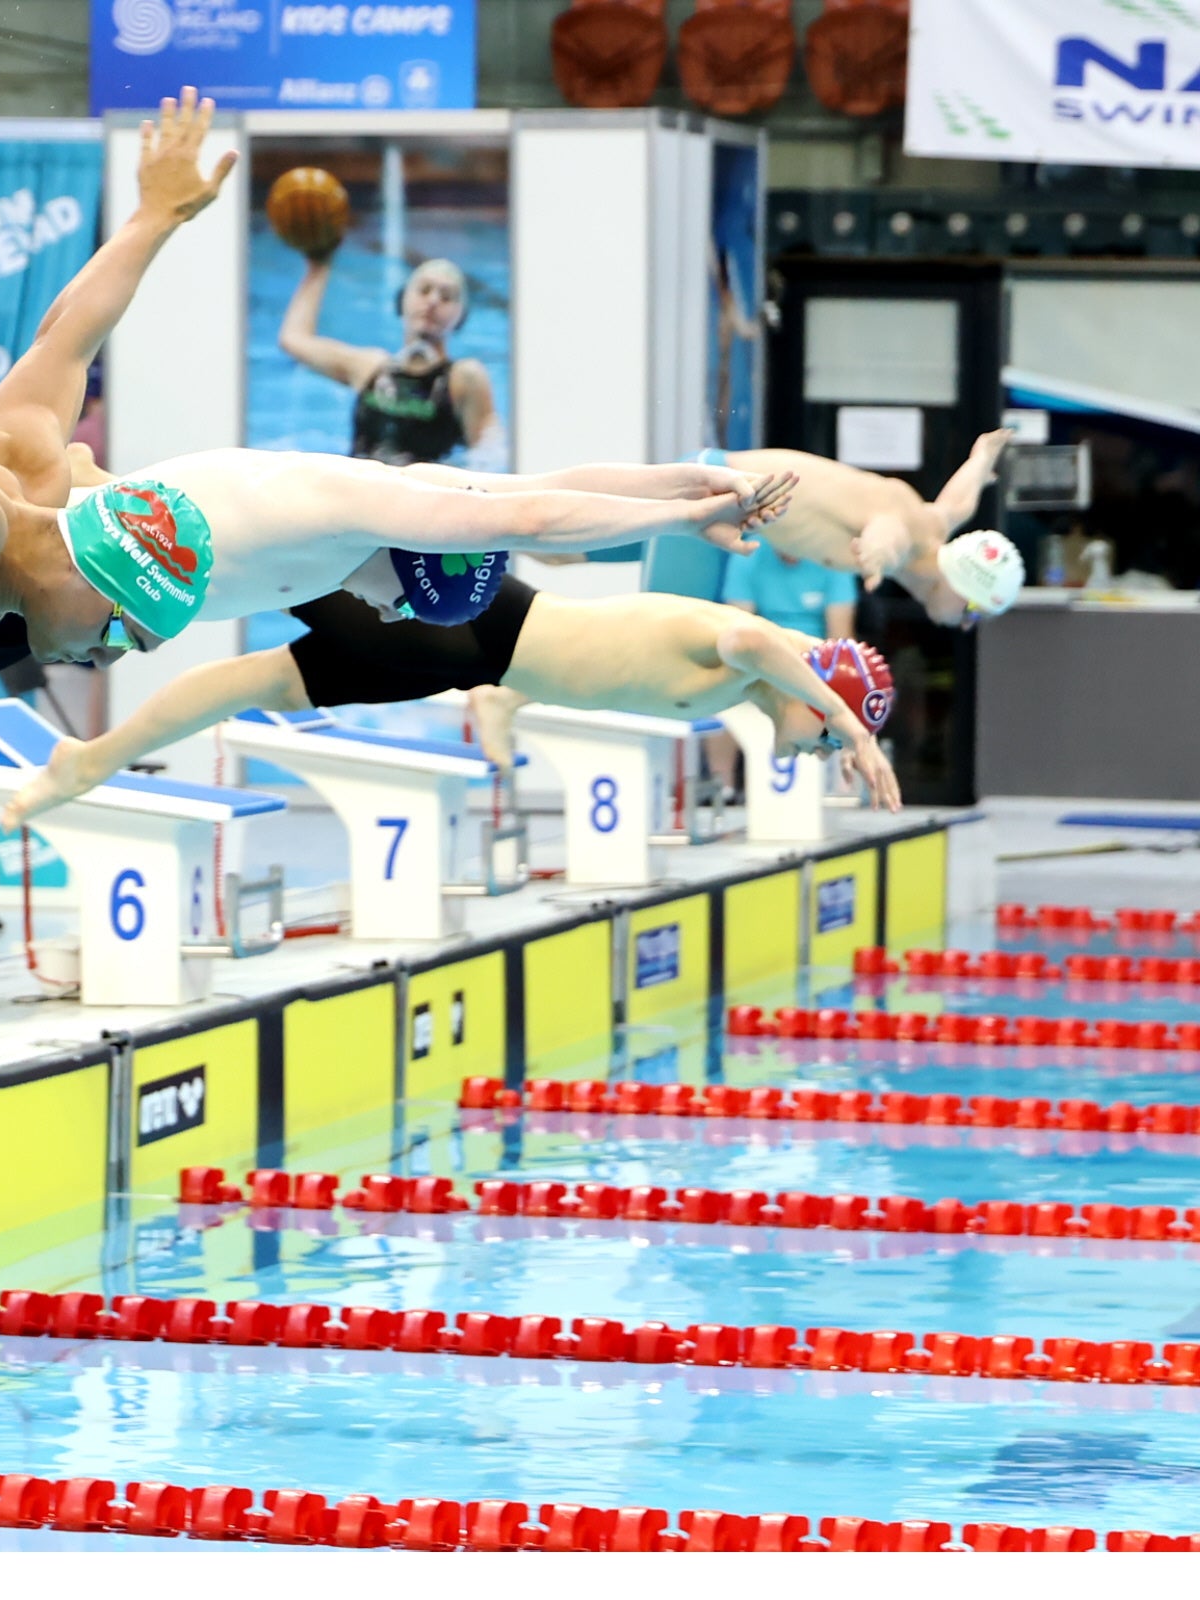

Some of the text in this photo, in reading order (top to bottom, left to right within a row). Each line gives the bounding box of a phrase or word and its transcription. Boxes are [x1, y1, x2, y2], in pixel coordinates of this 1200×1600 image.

[281, 5, 453, 36] KIDS CAMPS
[1054, 37, 1200, 91] N
[140, 520, 173, 551] est.1924
[118, 533, 155, 569] Well
[146, 564, 196, 607] Swimming
[135, 575, 162, 602] Club
[412, 554, 440, 605] Team
[770, 752, 797, 794] 9
[590, 775, 620, 834] 8
[376, 816, 410, 881] 7
[109, 867, 147, 942] 6
